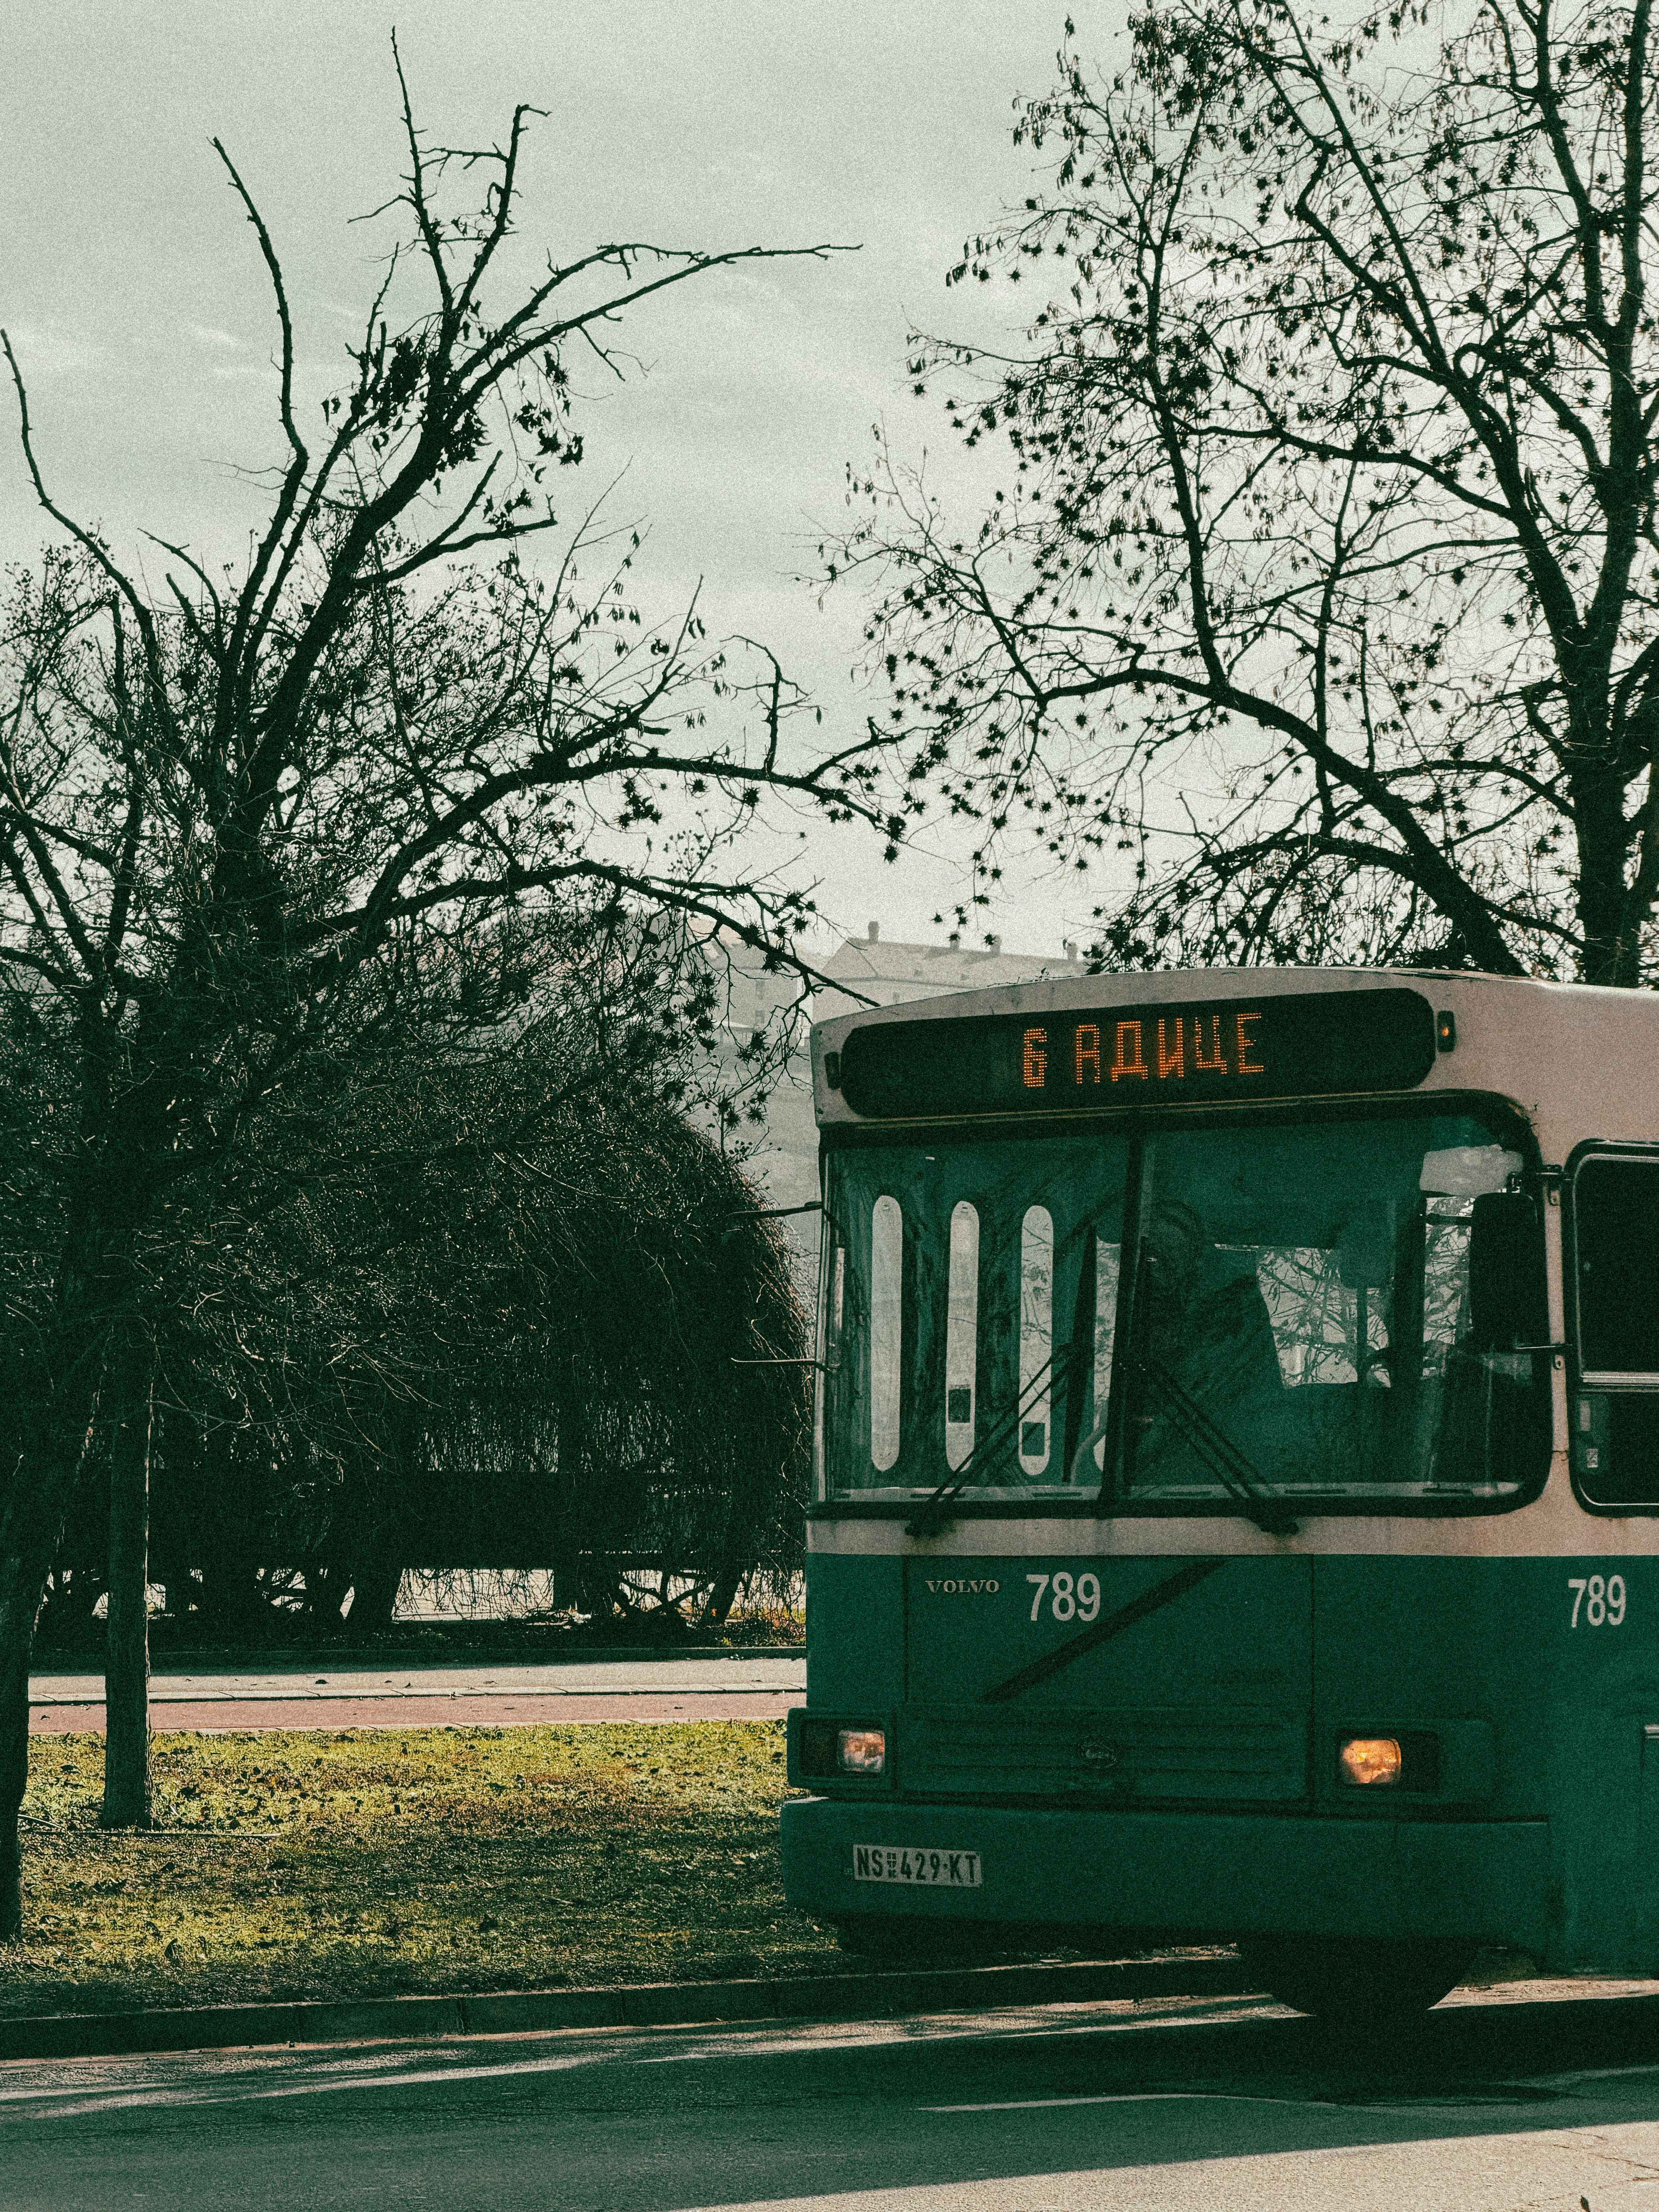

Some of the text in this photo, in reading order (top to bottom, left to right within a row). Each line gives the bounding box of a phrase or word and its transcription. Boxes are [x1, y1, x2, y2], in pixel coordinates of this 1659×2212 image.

[1023, 1012, 1264, 1087] 6 АДИЦЕ
[925, 1580, 999, 1593] VOLVO
[1026, 1572, 1101, 1621] 789
[1568, 1574, 1626, 1628] 789
